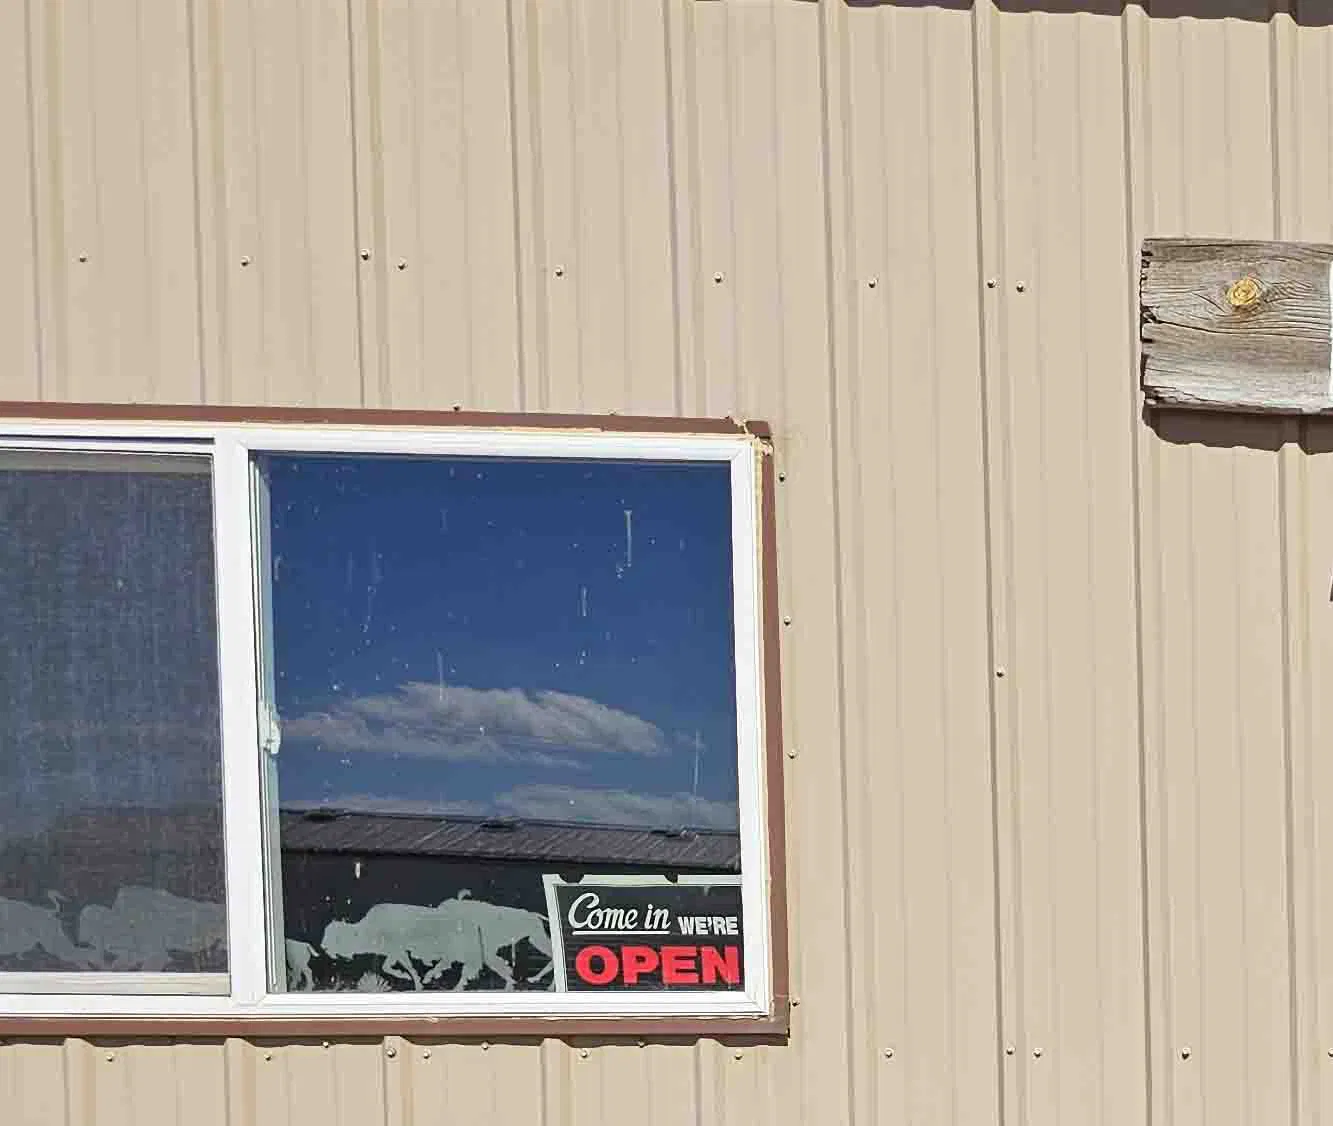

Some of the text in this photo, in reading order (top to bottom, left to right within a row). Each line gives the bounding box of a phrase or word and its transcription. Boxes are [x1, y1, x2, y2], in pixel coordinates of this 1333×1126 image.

[568, 892, 739, 935] Come in WE'RE
[576, 944, 740, 985] OPEN
